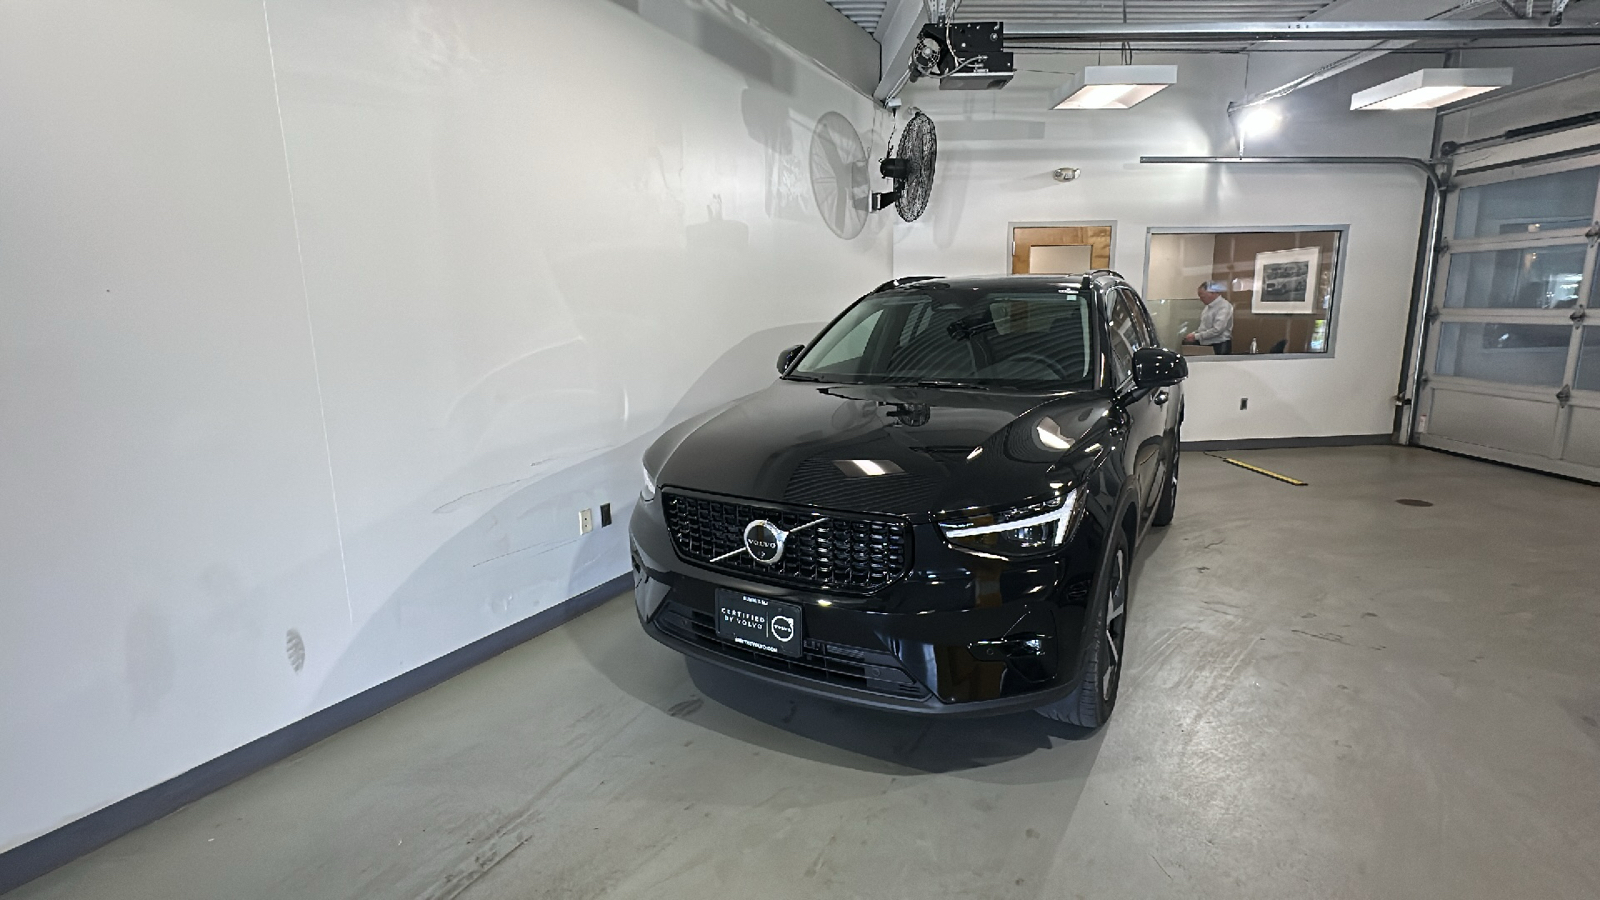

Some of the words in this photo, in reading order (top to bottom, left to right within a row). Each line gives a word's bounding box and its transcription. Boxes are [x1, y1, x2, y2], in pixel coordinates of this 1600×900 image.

[748, 539, 776, 549] VOLVO
[721, 607, 765, 623] CERTIFIED
[724, 614, 734, 622] BY
[736, 618, 763, 630] VOLVO
